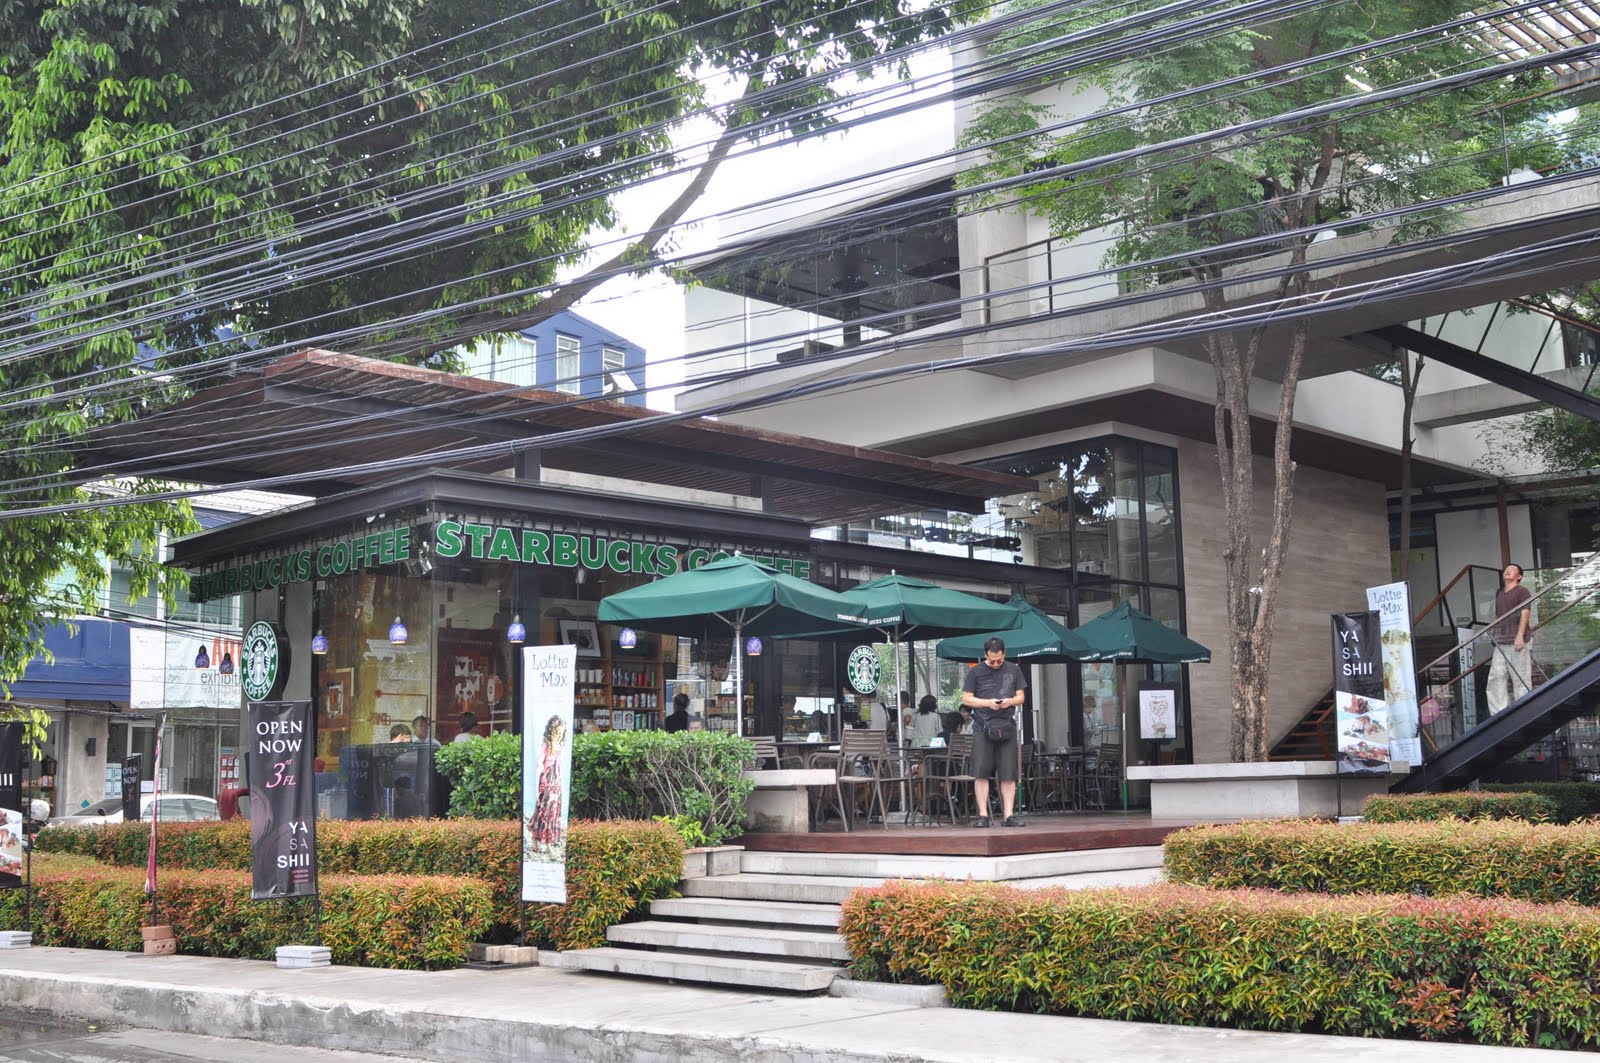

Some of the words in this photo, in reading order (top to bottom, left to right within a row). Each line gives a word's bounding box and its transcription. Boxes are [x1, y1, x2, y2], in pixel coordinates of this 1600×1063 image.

[435, 521, 679, 577] STARBUCKS
[688, 549, 810, 583] CEE
[189, 549, 312, 603] STARBUCKS
[316, 526, 410, 577] COFFEE
[1373, 590, 1402, 604] Lottie
[1381, 602, 1403, 615] Max
[242, 624, 277, 660] STARBUCKS
[1340, 630, 1359, 643] YA
[849, 647, 880, 669] STARBUCKS
[1342, 646, 1361, 660] SA
[531, 654, 569, 670] Lottie
[1342, 662, 1373, 676] SHII
[540, 671, 568, 688] Max
[852, 678, 877, 691] COFFEE
[244, 676, 272, 698] COFFEE
[256, 720, 303, 735] OPEN
[259, 739, 303, 754] NOW
[122, 766, 138, 775] OPEN
[123, 776, 137, 785] NOW
[282, 775, 297, 786] FL
[289, 821, 308, 834] YA
[289, 837, 309, 850] SA
[277, 853, 309, 868] SHII
